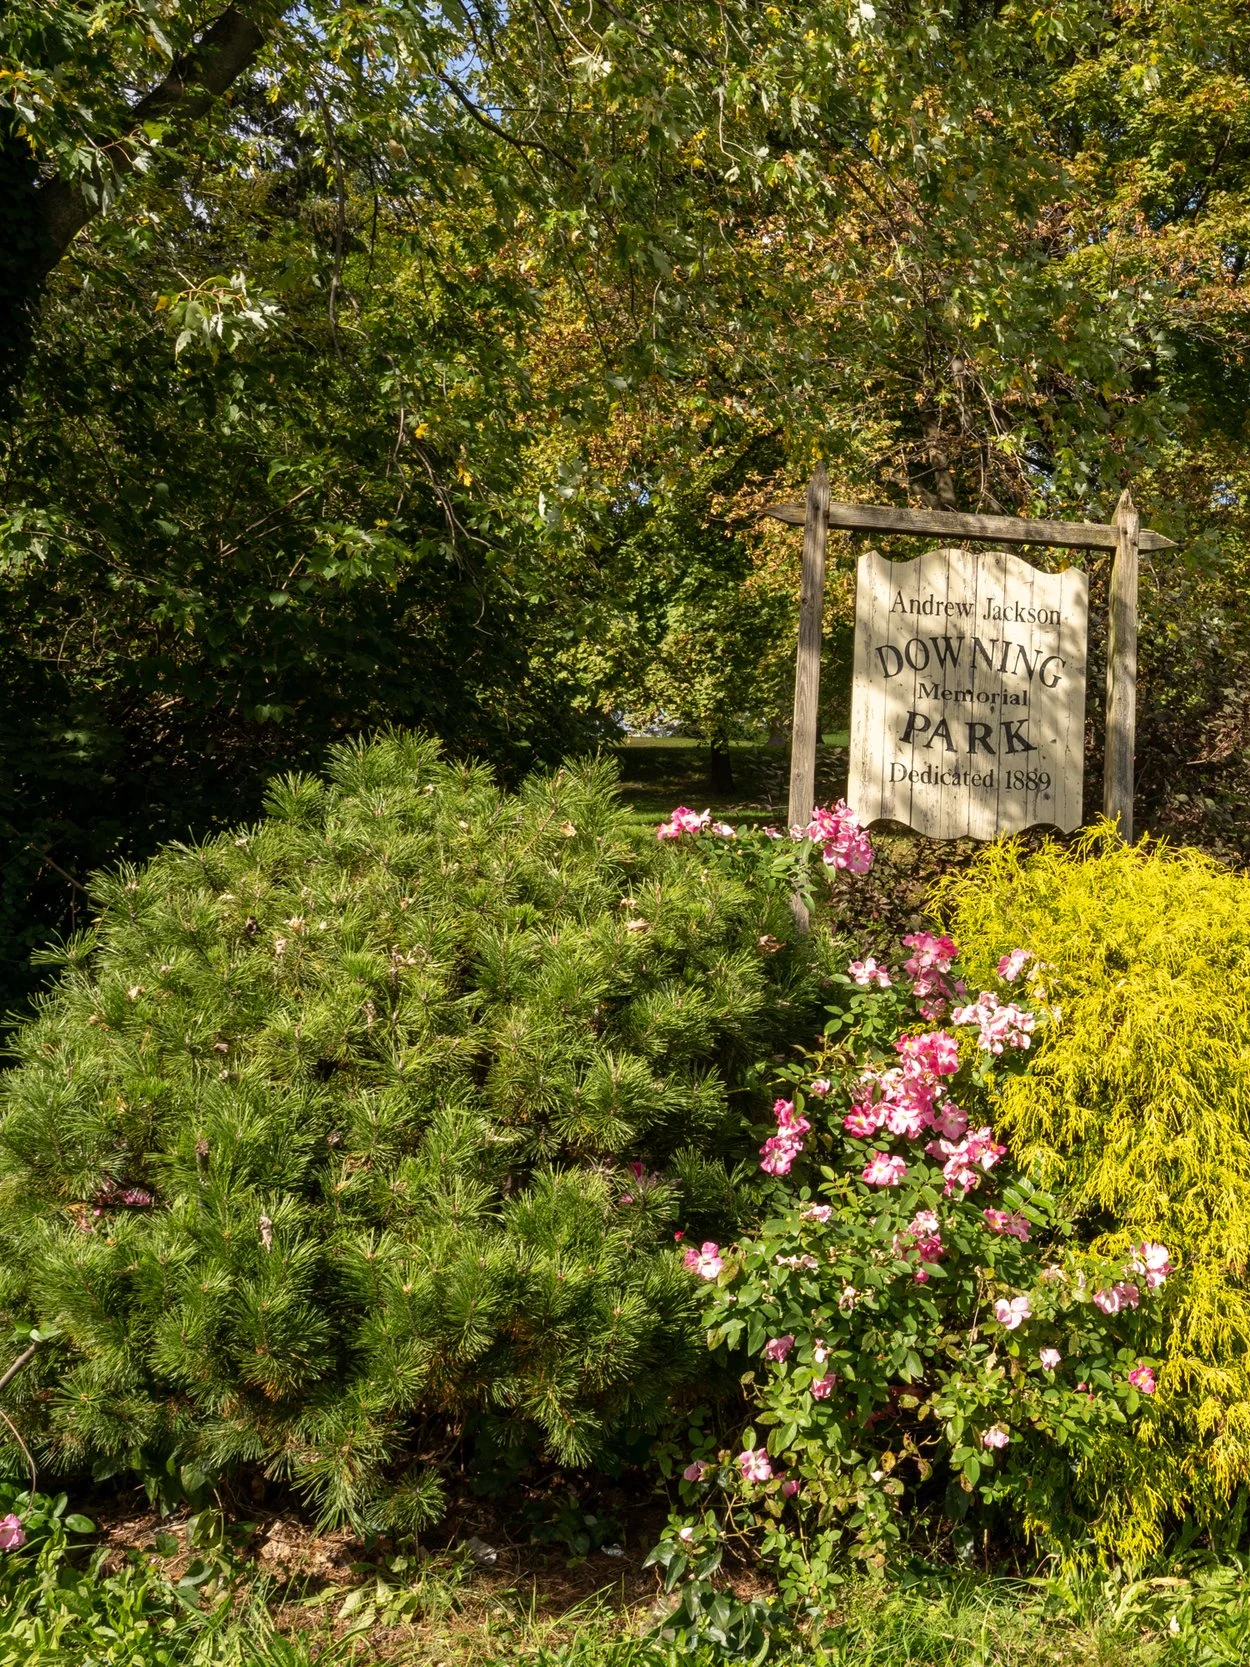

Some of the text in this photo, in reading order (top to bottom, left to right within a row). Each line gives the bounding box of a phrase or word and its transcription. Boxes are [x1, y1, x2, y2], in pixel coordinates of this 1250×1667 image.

[890, 590, 1061, 625] Andrew Jackson
[875, 636, 1067, 689] DOWNING
[918, 682, 1028, 706] Memorial
[899, 710, 1037, 754] PARK
[889, 762, 1051, 792] Dedicated 1889
